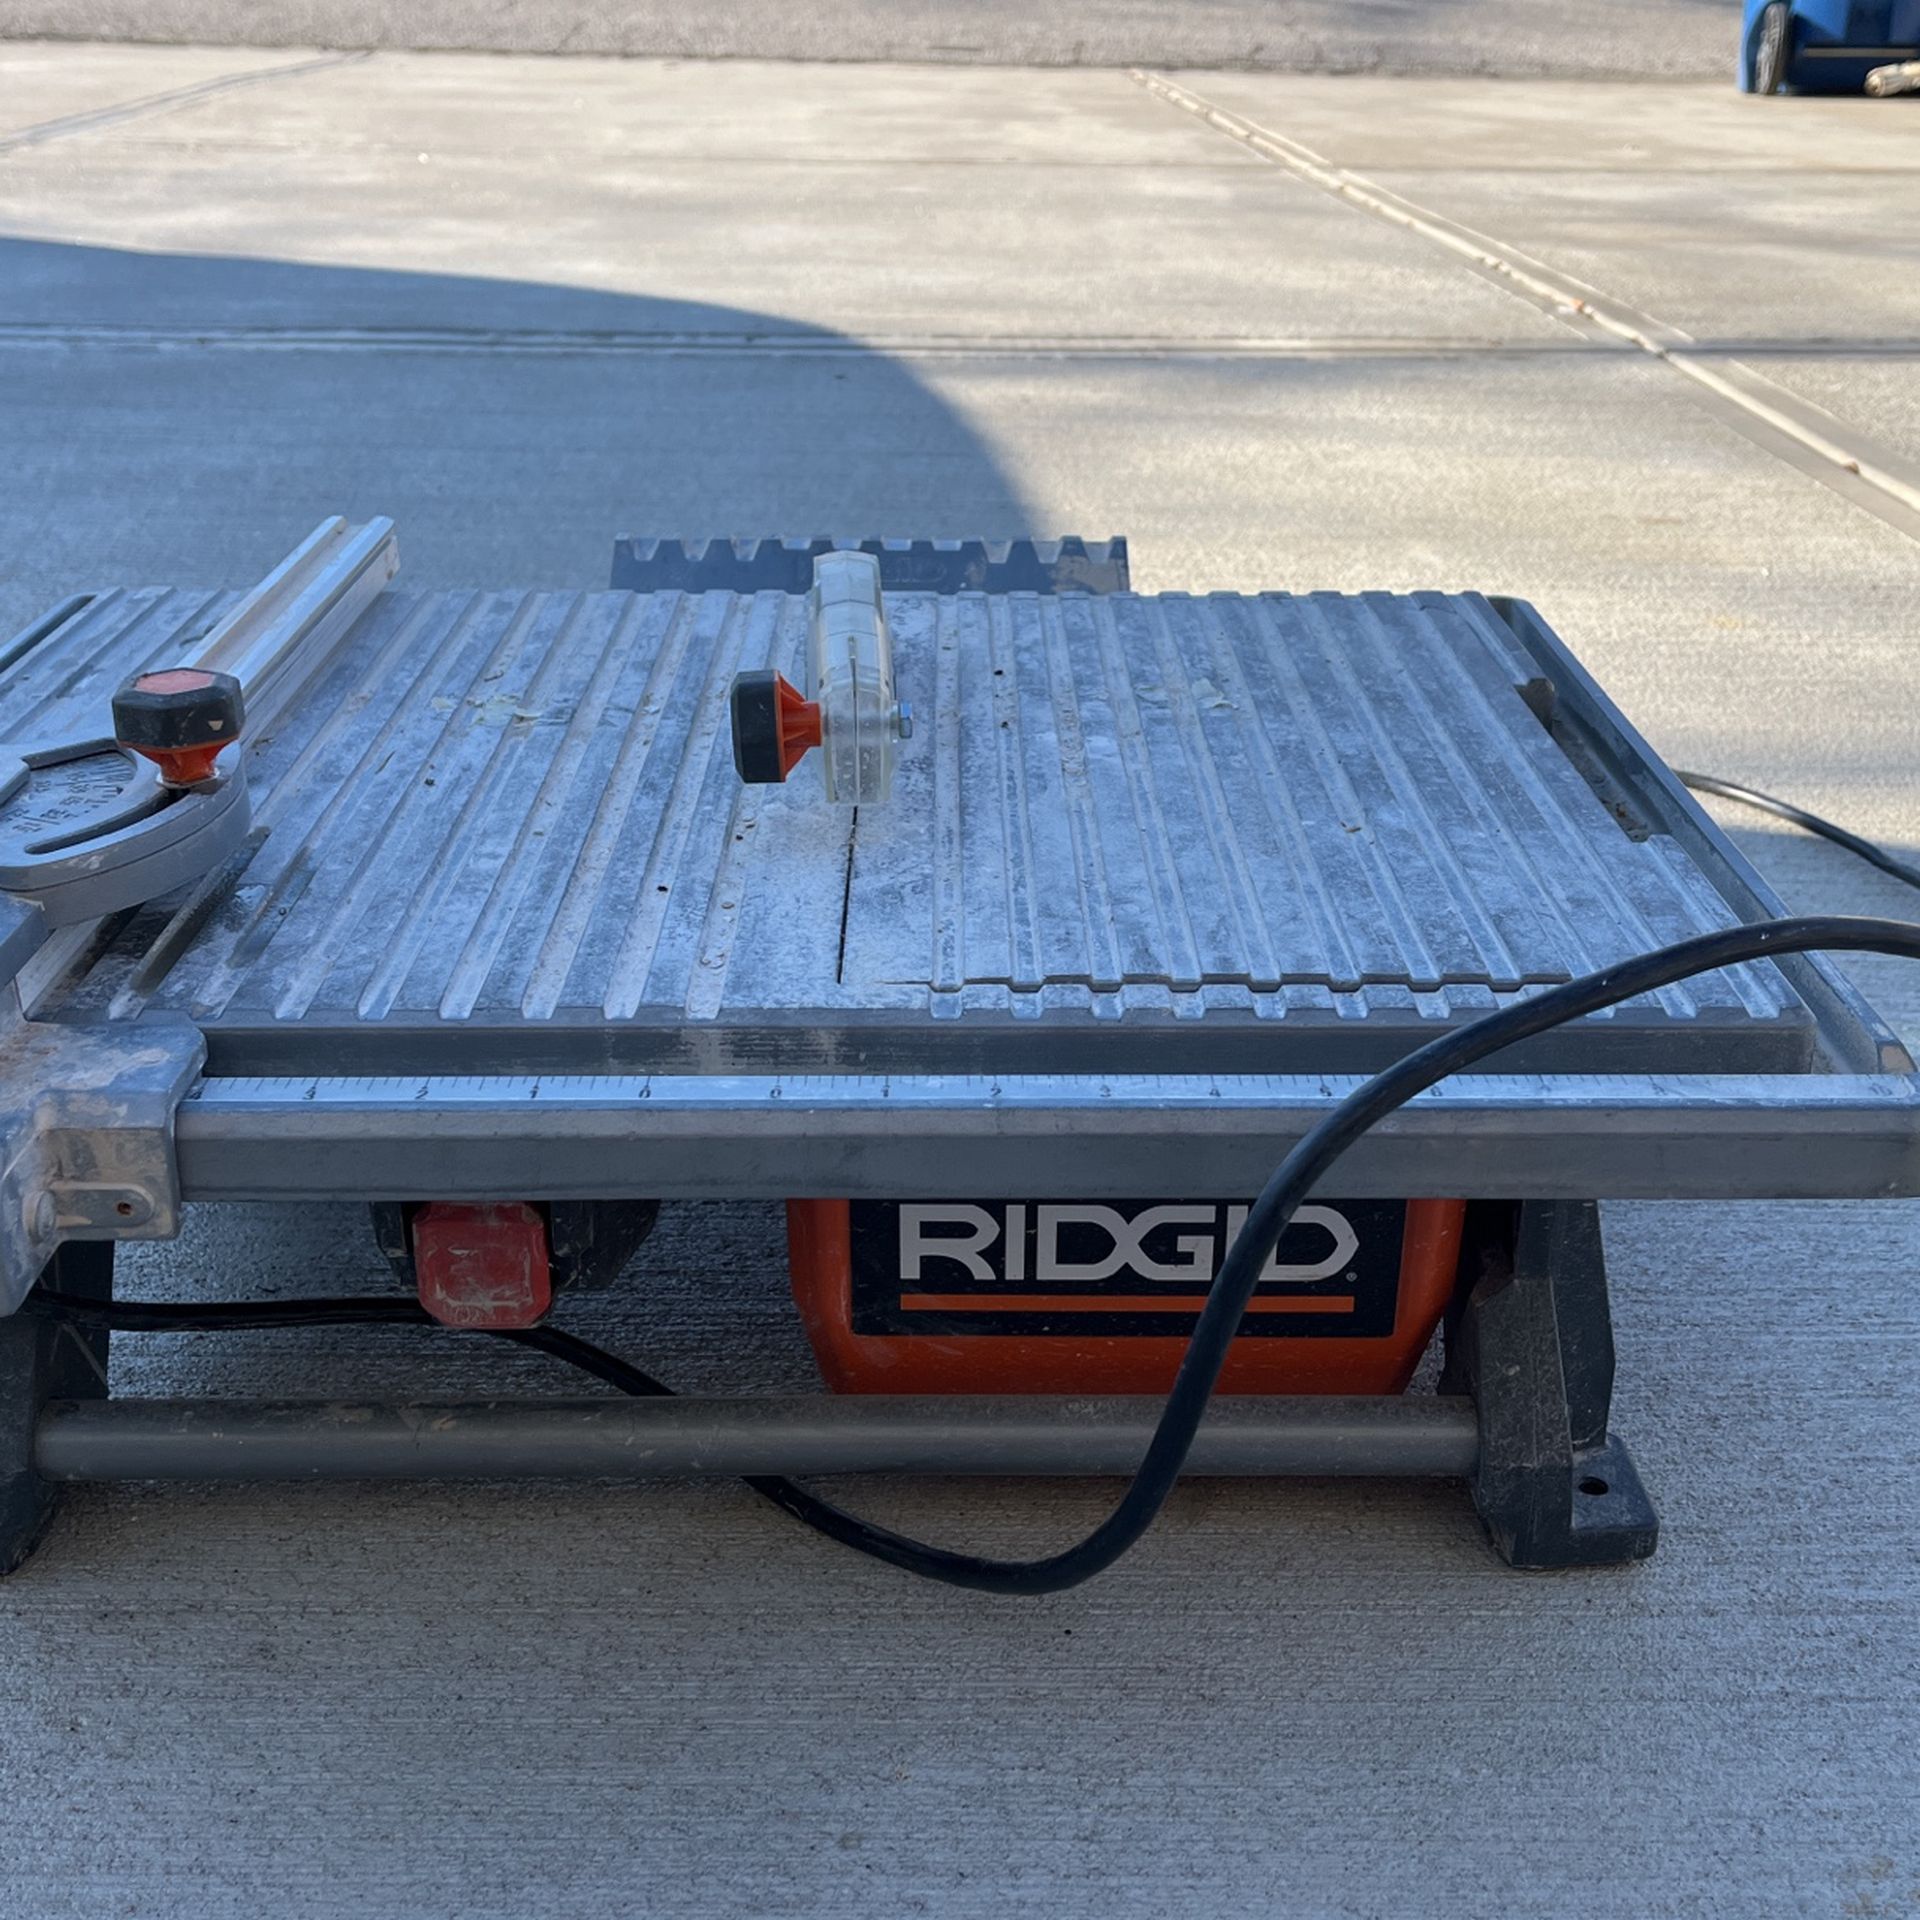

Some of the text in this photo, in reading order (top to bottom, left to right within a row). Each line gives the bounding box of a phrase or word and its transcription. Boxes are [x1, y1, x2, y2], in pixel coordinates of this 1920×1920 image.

[302, 1088, 316, 1100] 3
[415, 1088, 429, 1100] 2
[638, 1087, 652, 1099] 0
[769, 1087, 783, 1099] 0
